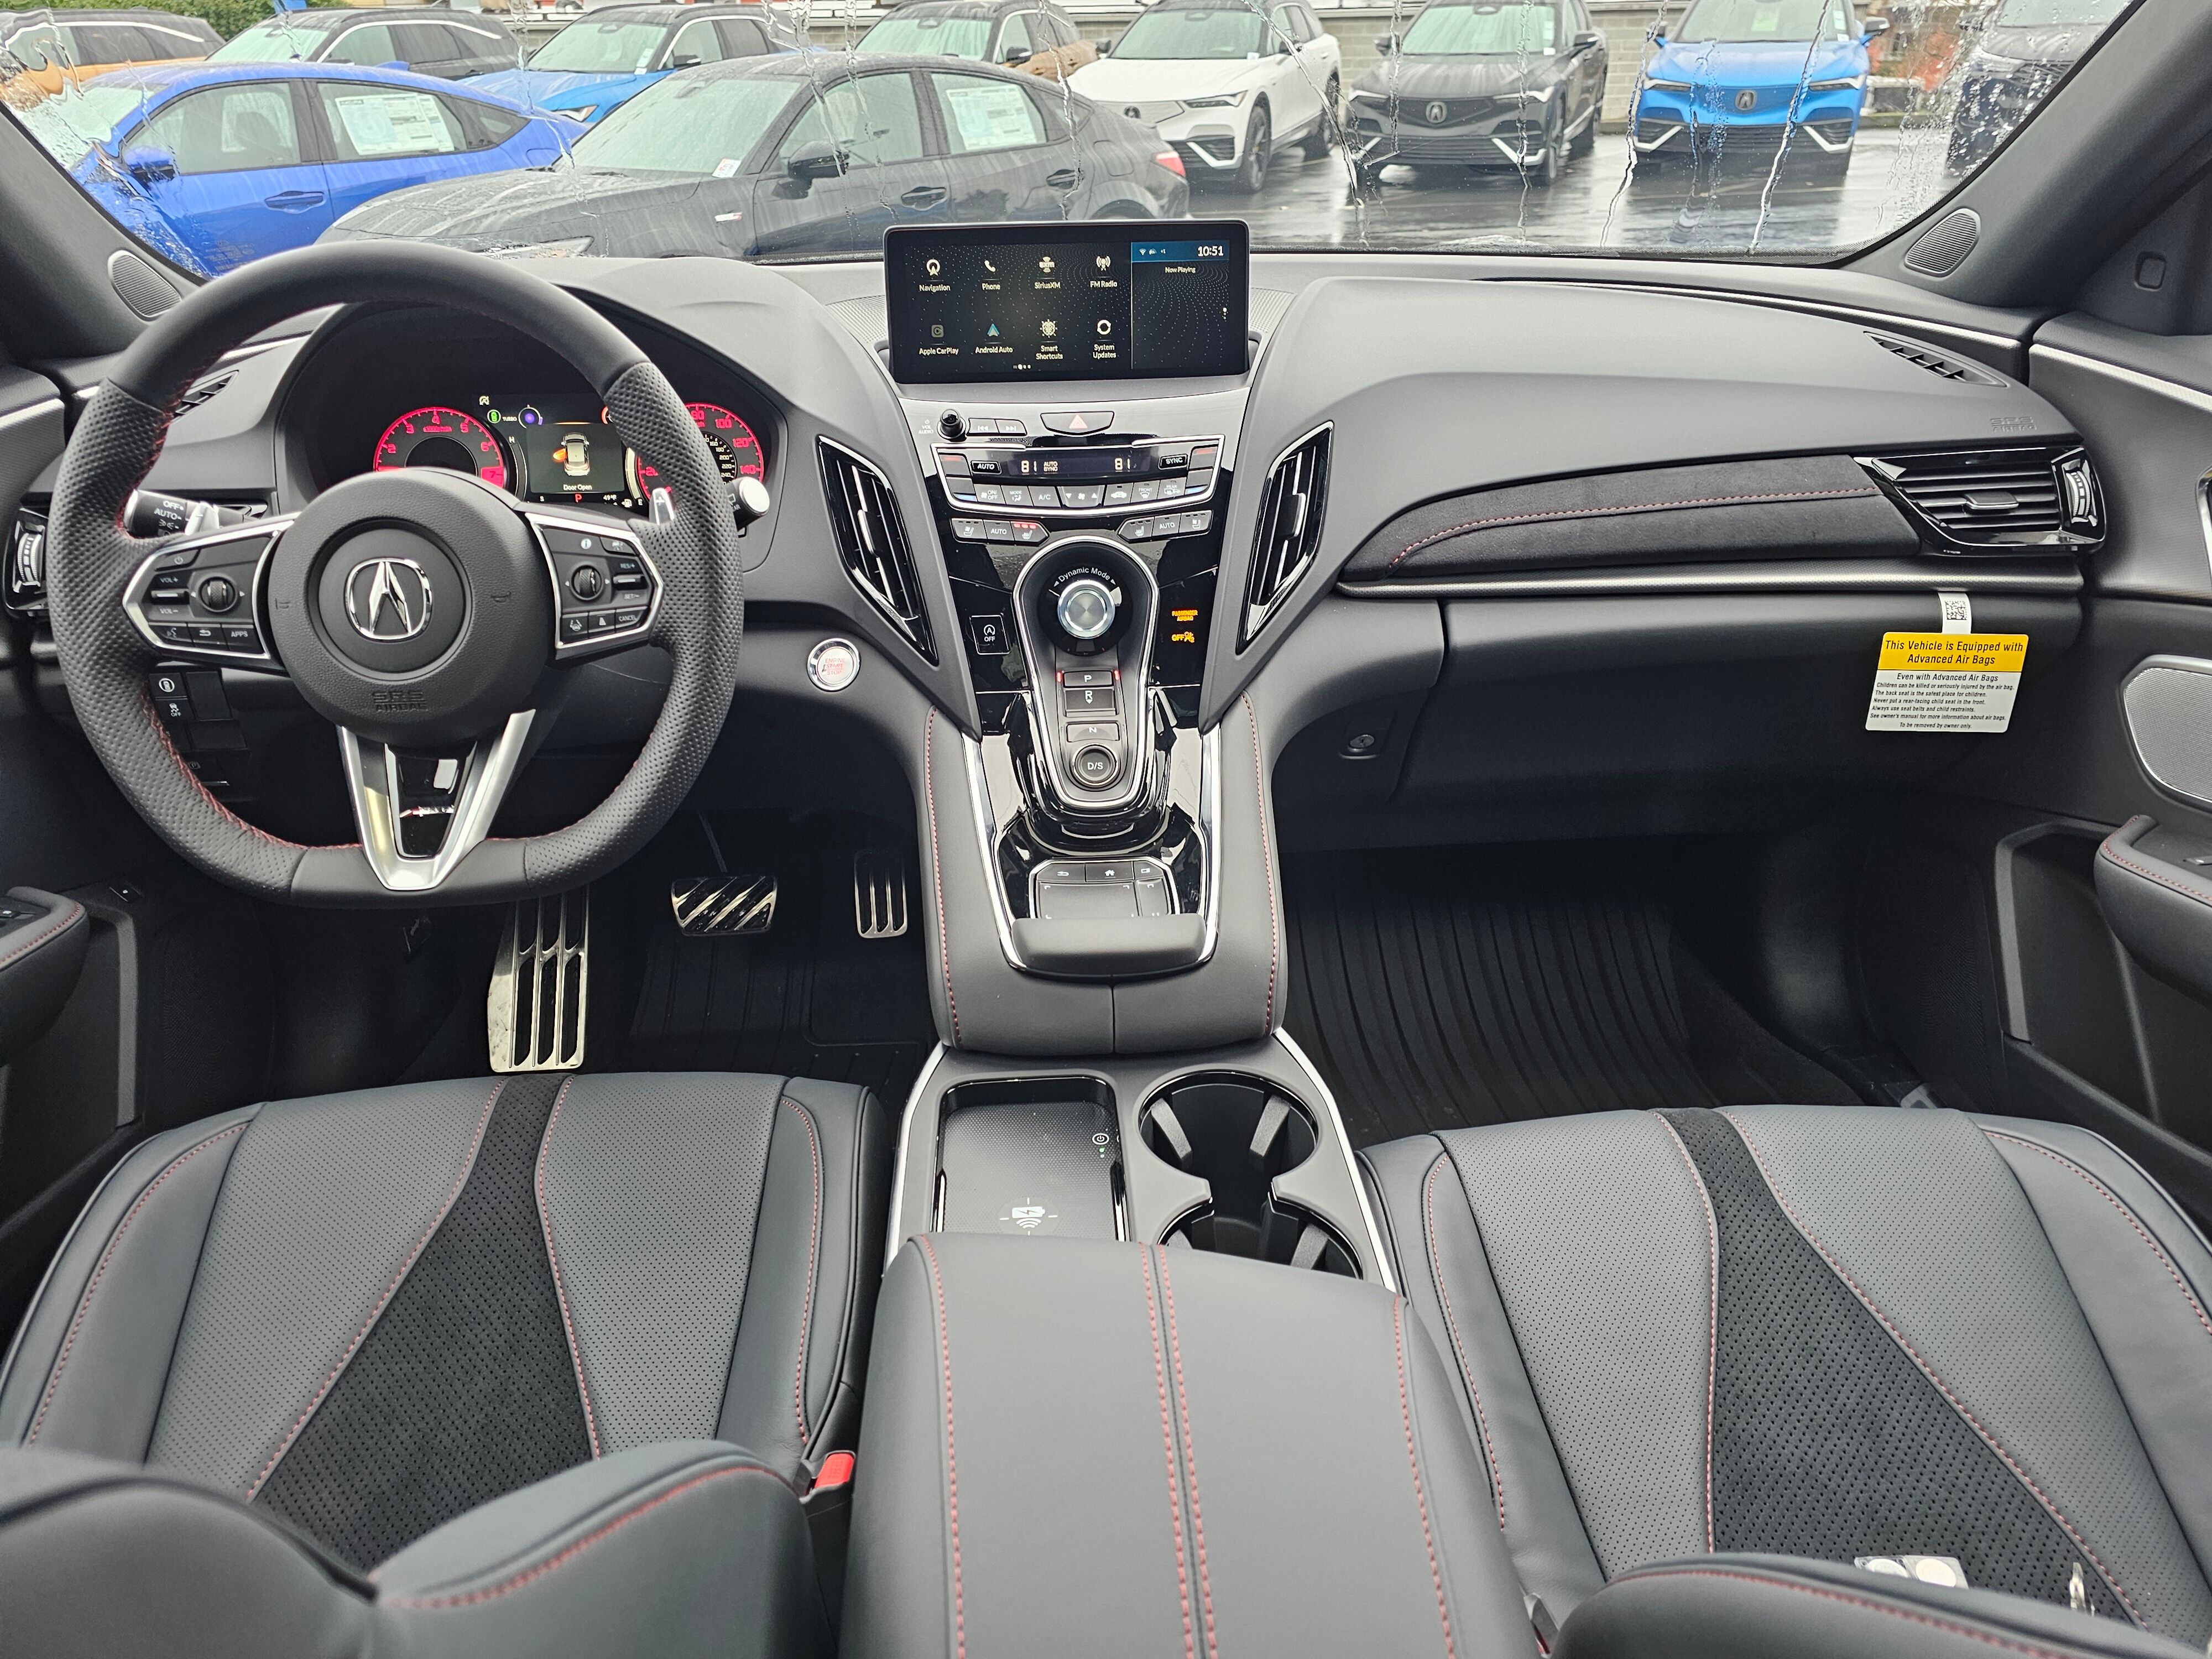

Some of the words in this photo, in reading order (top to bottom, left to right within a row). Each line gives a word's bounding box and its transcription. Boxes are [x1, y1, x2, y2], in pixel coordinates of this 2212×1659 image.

[1197, 246, 1224, 257] 10:51
[919, 284, 951, 293] Navigation
[919, 347, 936, 356] Apple
[432, 415, 440, 425] 4
[406, 423, 414, 434] 3
[461, 422, 469, 432] 5
[387, 444, 396, 453] 2
[481, 442, 489, 452] 6
[1021, 460, 1037, 472] 81
[1114, 458, 1130, 470] 81
[575, 494, 582, 503] P
[163, 500, 180, 510] OFF
[154, 508, 178, 520] AUTO
[1058, 566, 1089, 582] Dynamic
[1091, 567, 1110, 581] Mode
[1885, 640, 1905, 649] This
[1908, 640, 1943, 650] Vehicle
[1945, 641, 1954, 650] is
[1957, 641, 2001, 653] Equipped
[2004, 642, 2023, 651] with
[1907, 654, 1953, 664] Advanced
[1955, 655, 1970, 664] Air
[1972, 655, 1996, 666] Bags
[1084, 675, 1092, 683] P
[1981, 674, 1999, 682] Bags
[1085, 691, 1093, 700] R
[1087, 762, 1104, 770] D/S
